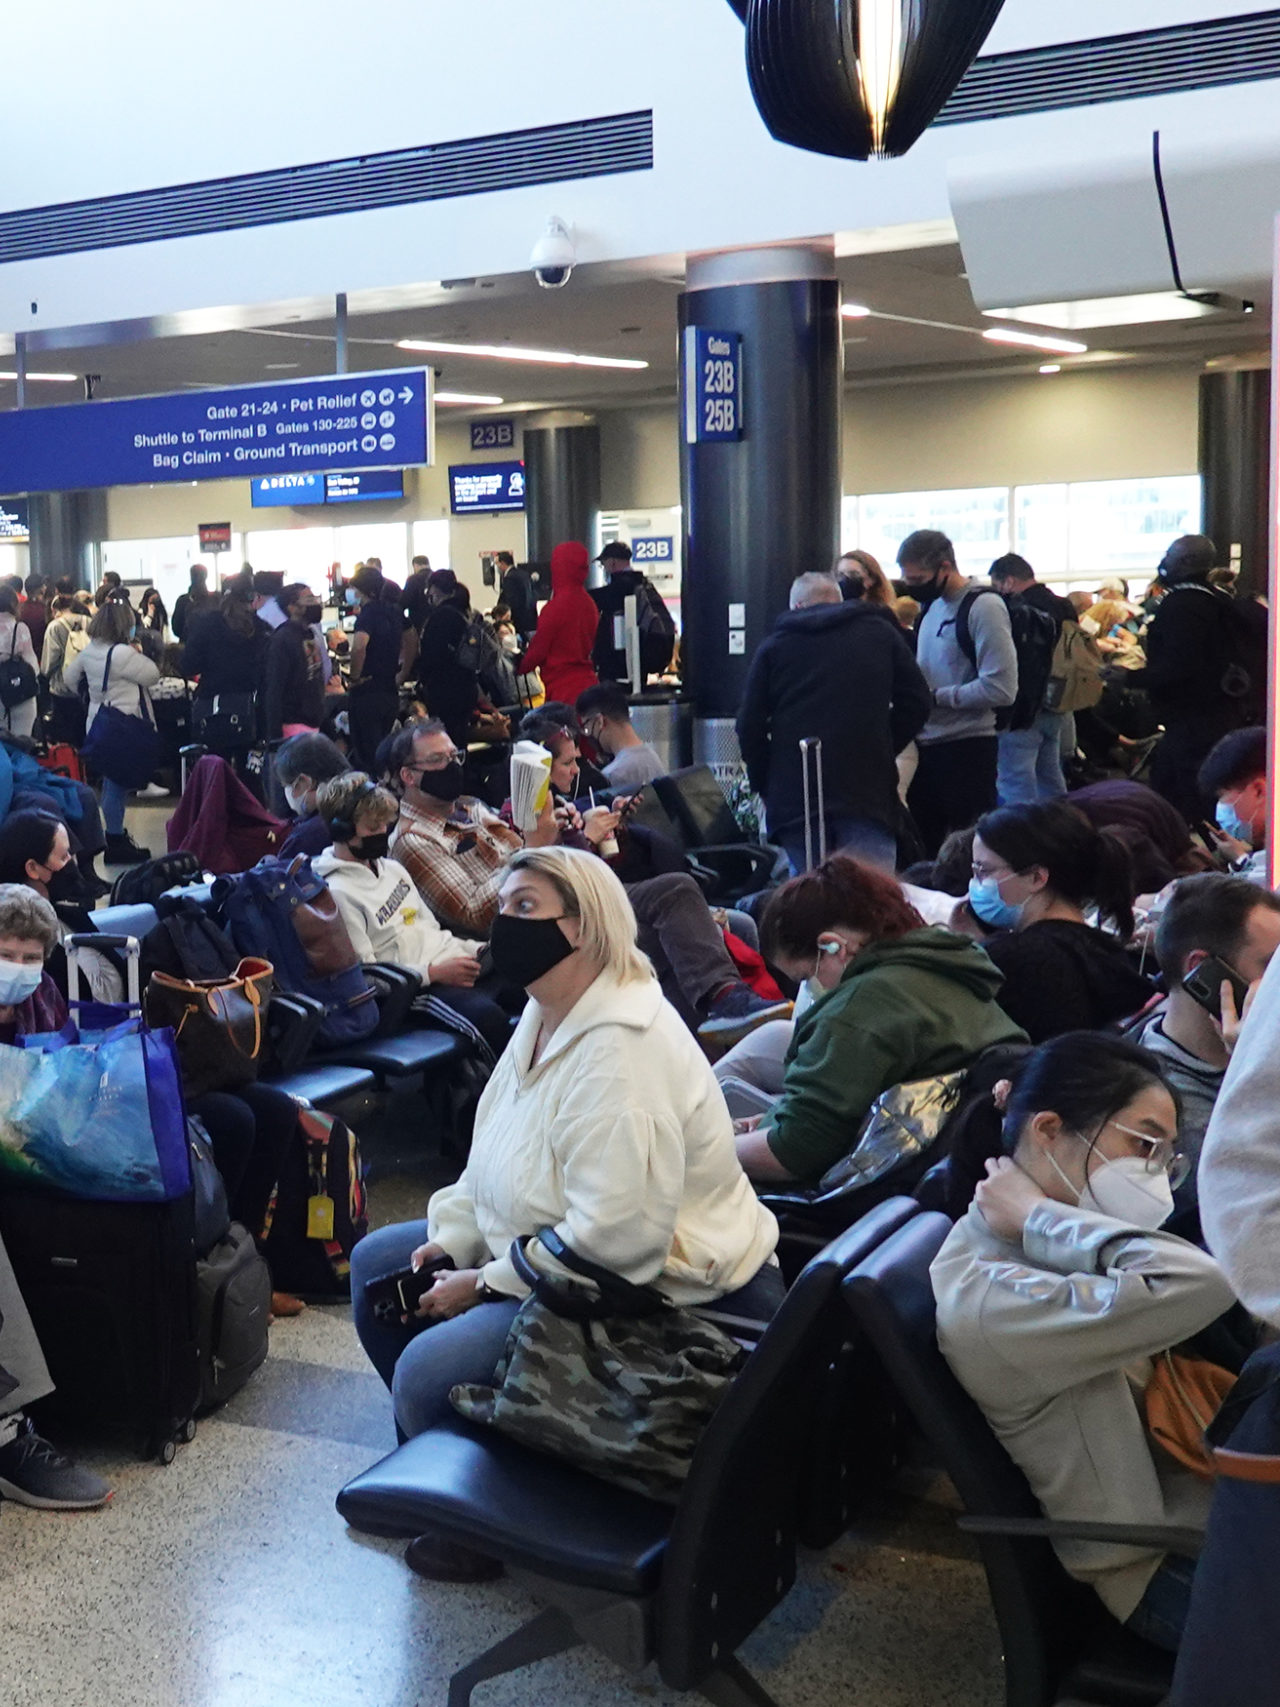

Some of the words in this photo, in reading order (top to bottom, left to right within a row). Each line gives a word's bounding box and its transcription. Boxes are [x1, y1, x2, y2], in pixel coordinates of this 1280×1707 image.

[704, 360, 734, 394] 23B
[206, 405, 238, 420] Gate
[241, 401, 278, 417] 21-24
[290, 398, 313, 412] Pet
[317, 393, 357, 411] Relief
[705, 398, 734, 432] 25B
[133, 431, 178, 448] Shuttle
[182, 431, 195, 444] to
[198, 424, 253, 442] Terminal
[257, 423, 267, 438] B
[276, 422, 309, 434] Gates
[312, 416, 358, 432] 130-225
[473, 424, 512, 446] 23B
[153, 453, 179, 469] Bag
[182, 450, 221, 465] Claim
[233, 444, 285, 461] Ground
[288, 438, 358, 457] Transport
[271, 476, 305, 489] DELTA
[636, 541, 670, 558] 23B
